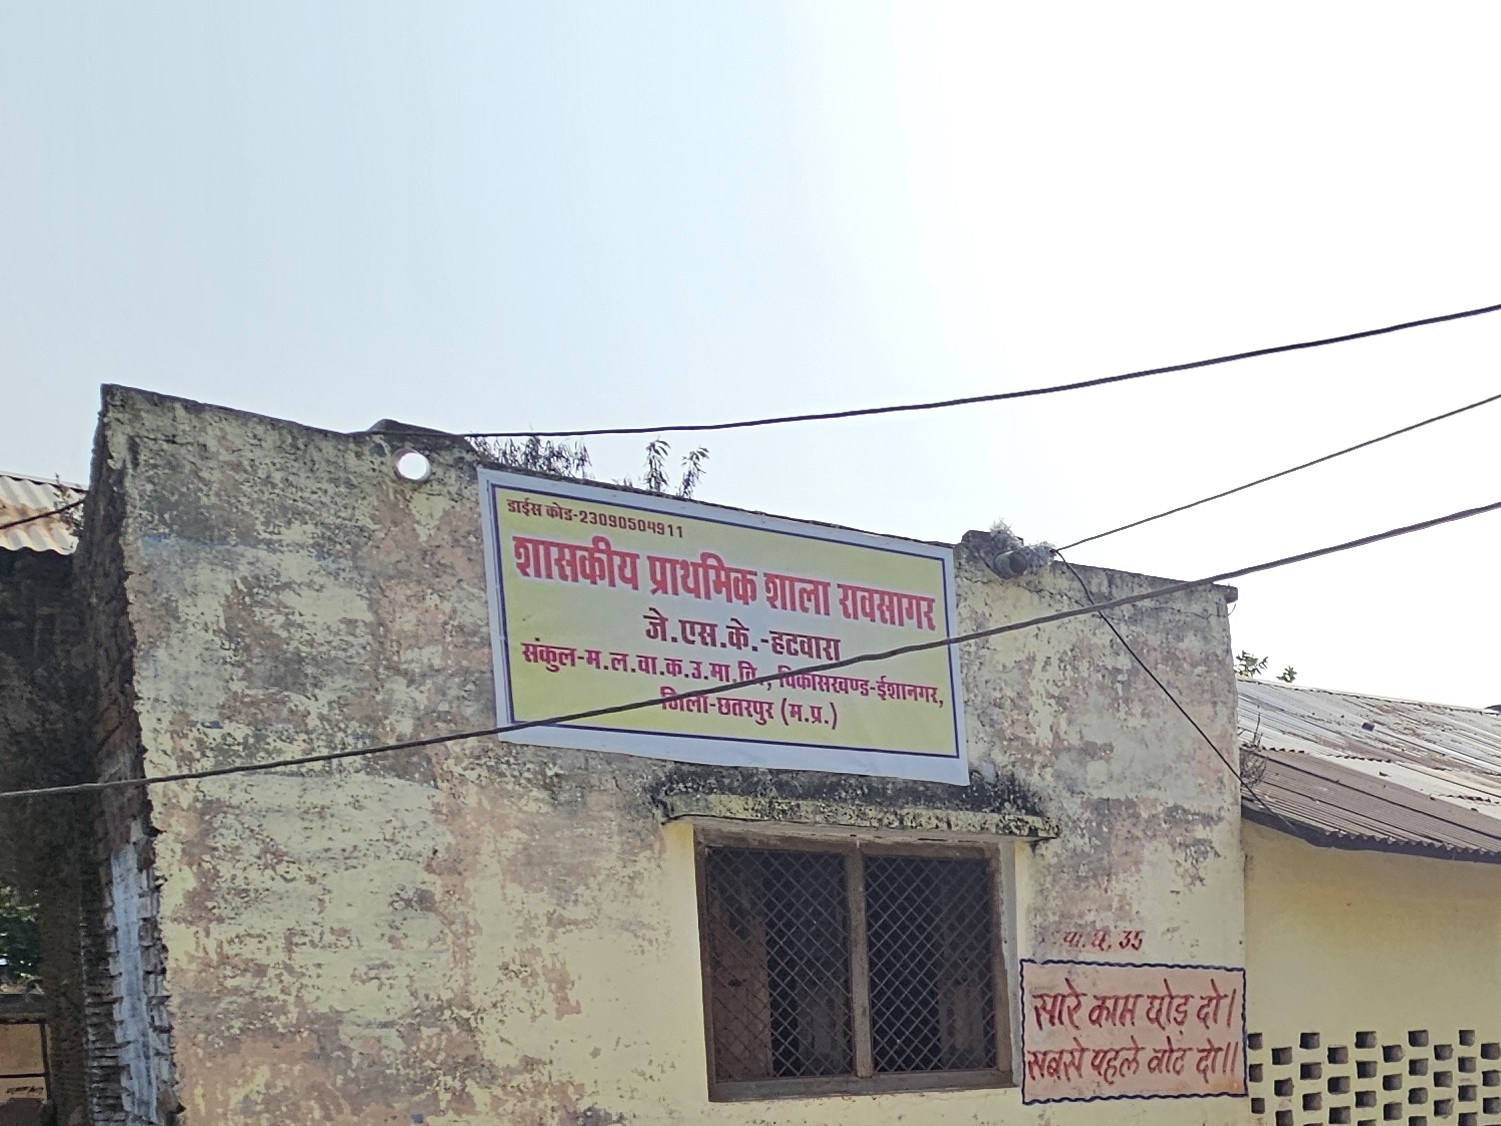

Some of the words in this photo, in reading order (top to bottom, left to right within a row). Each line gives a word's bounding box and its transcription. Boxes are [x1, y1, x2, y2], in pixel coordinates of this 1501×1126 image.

[506, 497, 543, 517] डाईस
[545, 502, 684, 538] कोड-23090504911
[512, 535, 640, 591] शासकीय
[646, 551, 758, 606] प्राथमिक
[763, 572, 831, 617] शाला
[836, 583, 937, 632] रावसागर
[780, 697, 838, 730] (म.प्र.)
[1032, 977, 1088, 1031] सारे
[1088, 993, 1145, 1027] काम
[1027, 1036, 1089, 1082] सबसे
[1090, 1035, 1146, 1085] पहले
[1147, 1035, 1193, 1077] वोट
